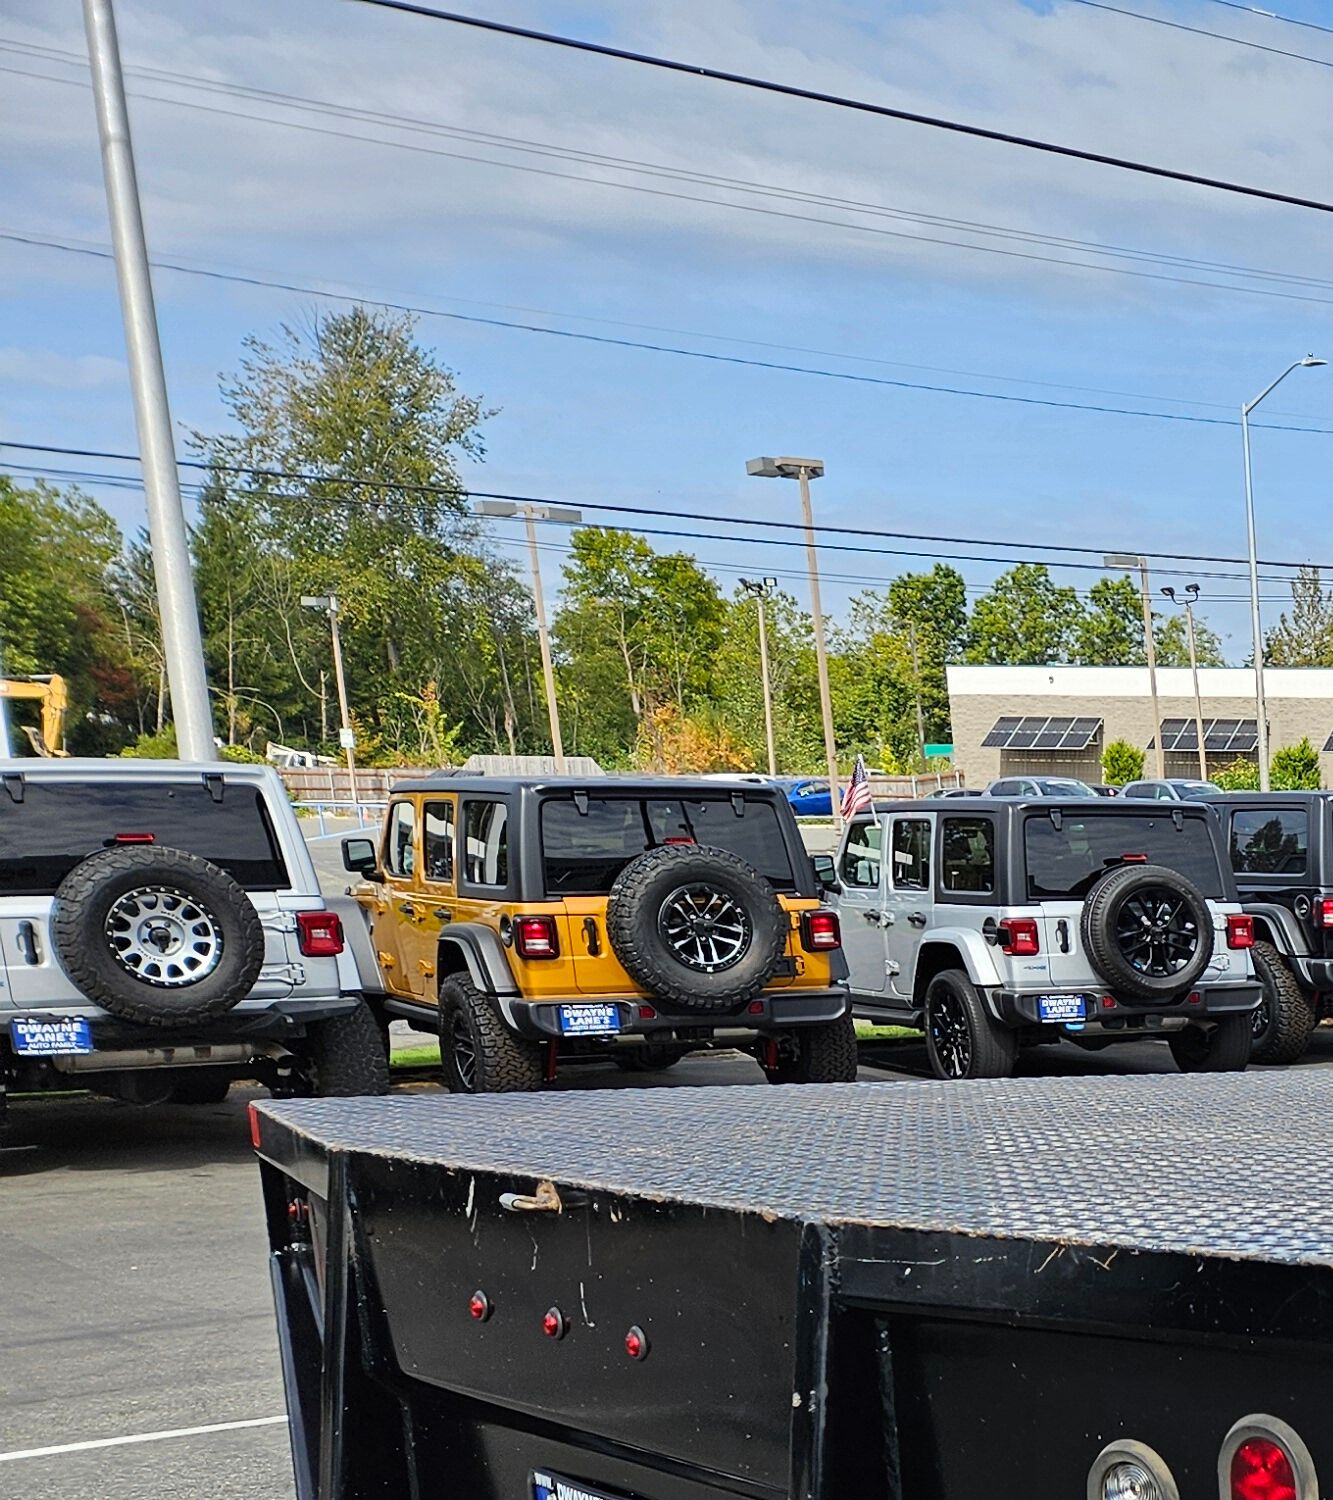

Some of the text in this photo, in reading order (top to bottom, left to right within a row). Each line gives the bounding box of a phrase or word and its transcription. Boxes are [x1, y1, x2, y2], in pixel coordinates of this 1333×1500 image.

[563, 1008, 614, 1018] DWAYNE
[569, 1016, 611, 1025] LANE'S
[17, 1022, 82, 1034] DWAYNE
[25, 1033, 77, 1042] LANE'S
